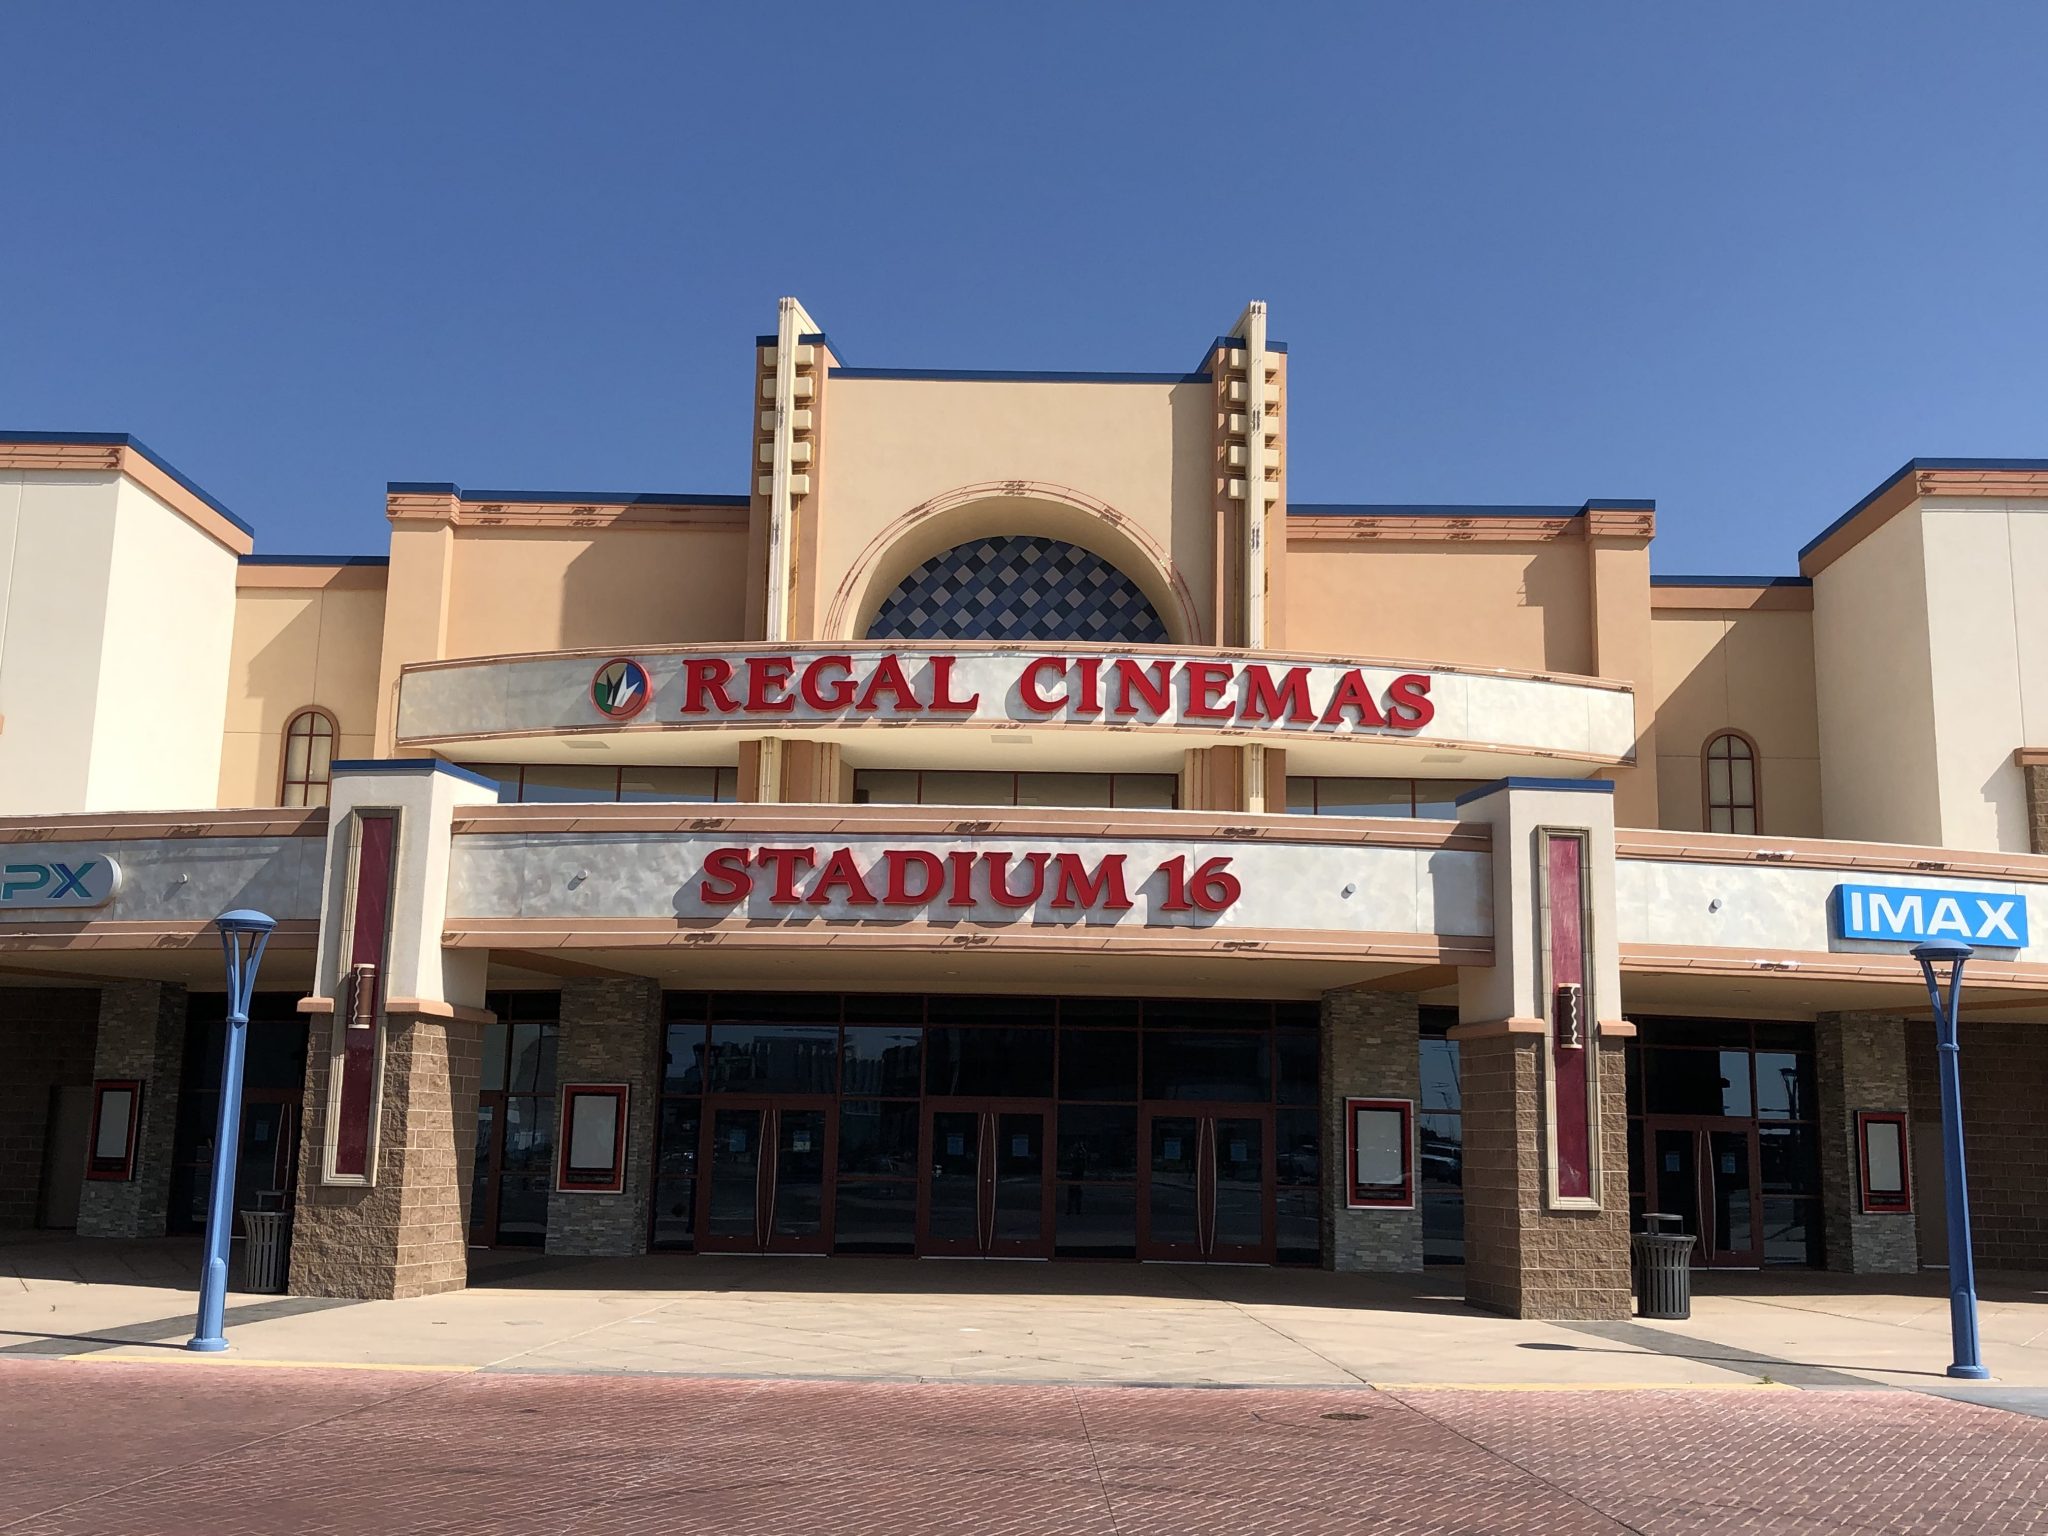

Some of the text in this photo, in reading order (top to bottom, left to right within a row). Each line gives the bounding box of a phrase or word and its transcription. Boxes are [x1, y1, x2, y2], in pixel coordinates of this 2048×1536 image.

[683, 654, 1435, 730] REGAL CINEMAS
[701, 848, 1241, 911] STADIUM 16
[1851, 892, 2019, 940] IMAX
